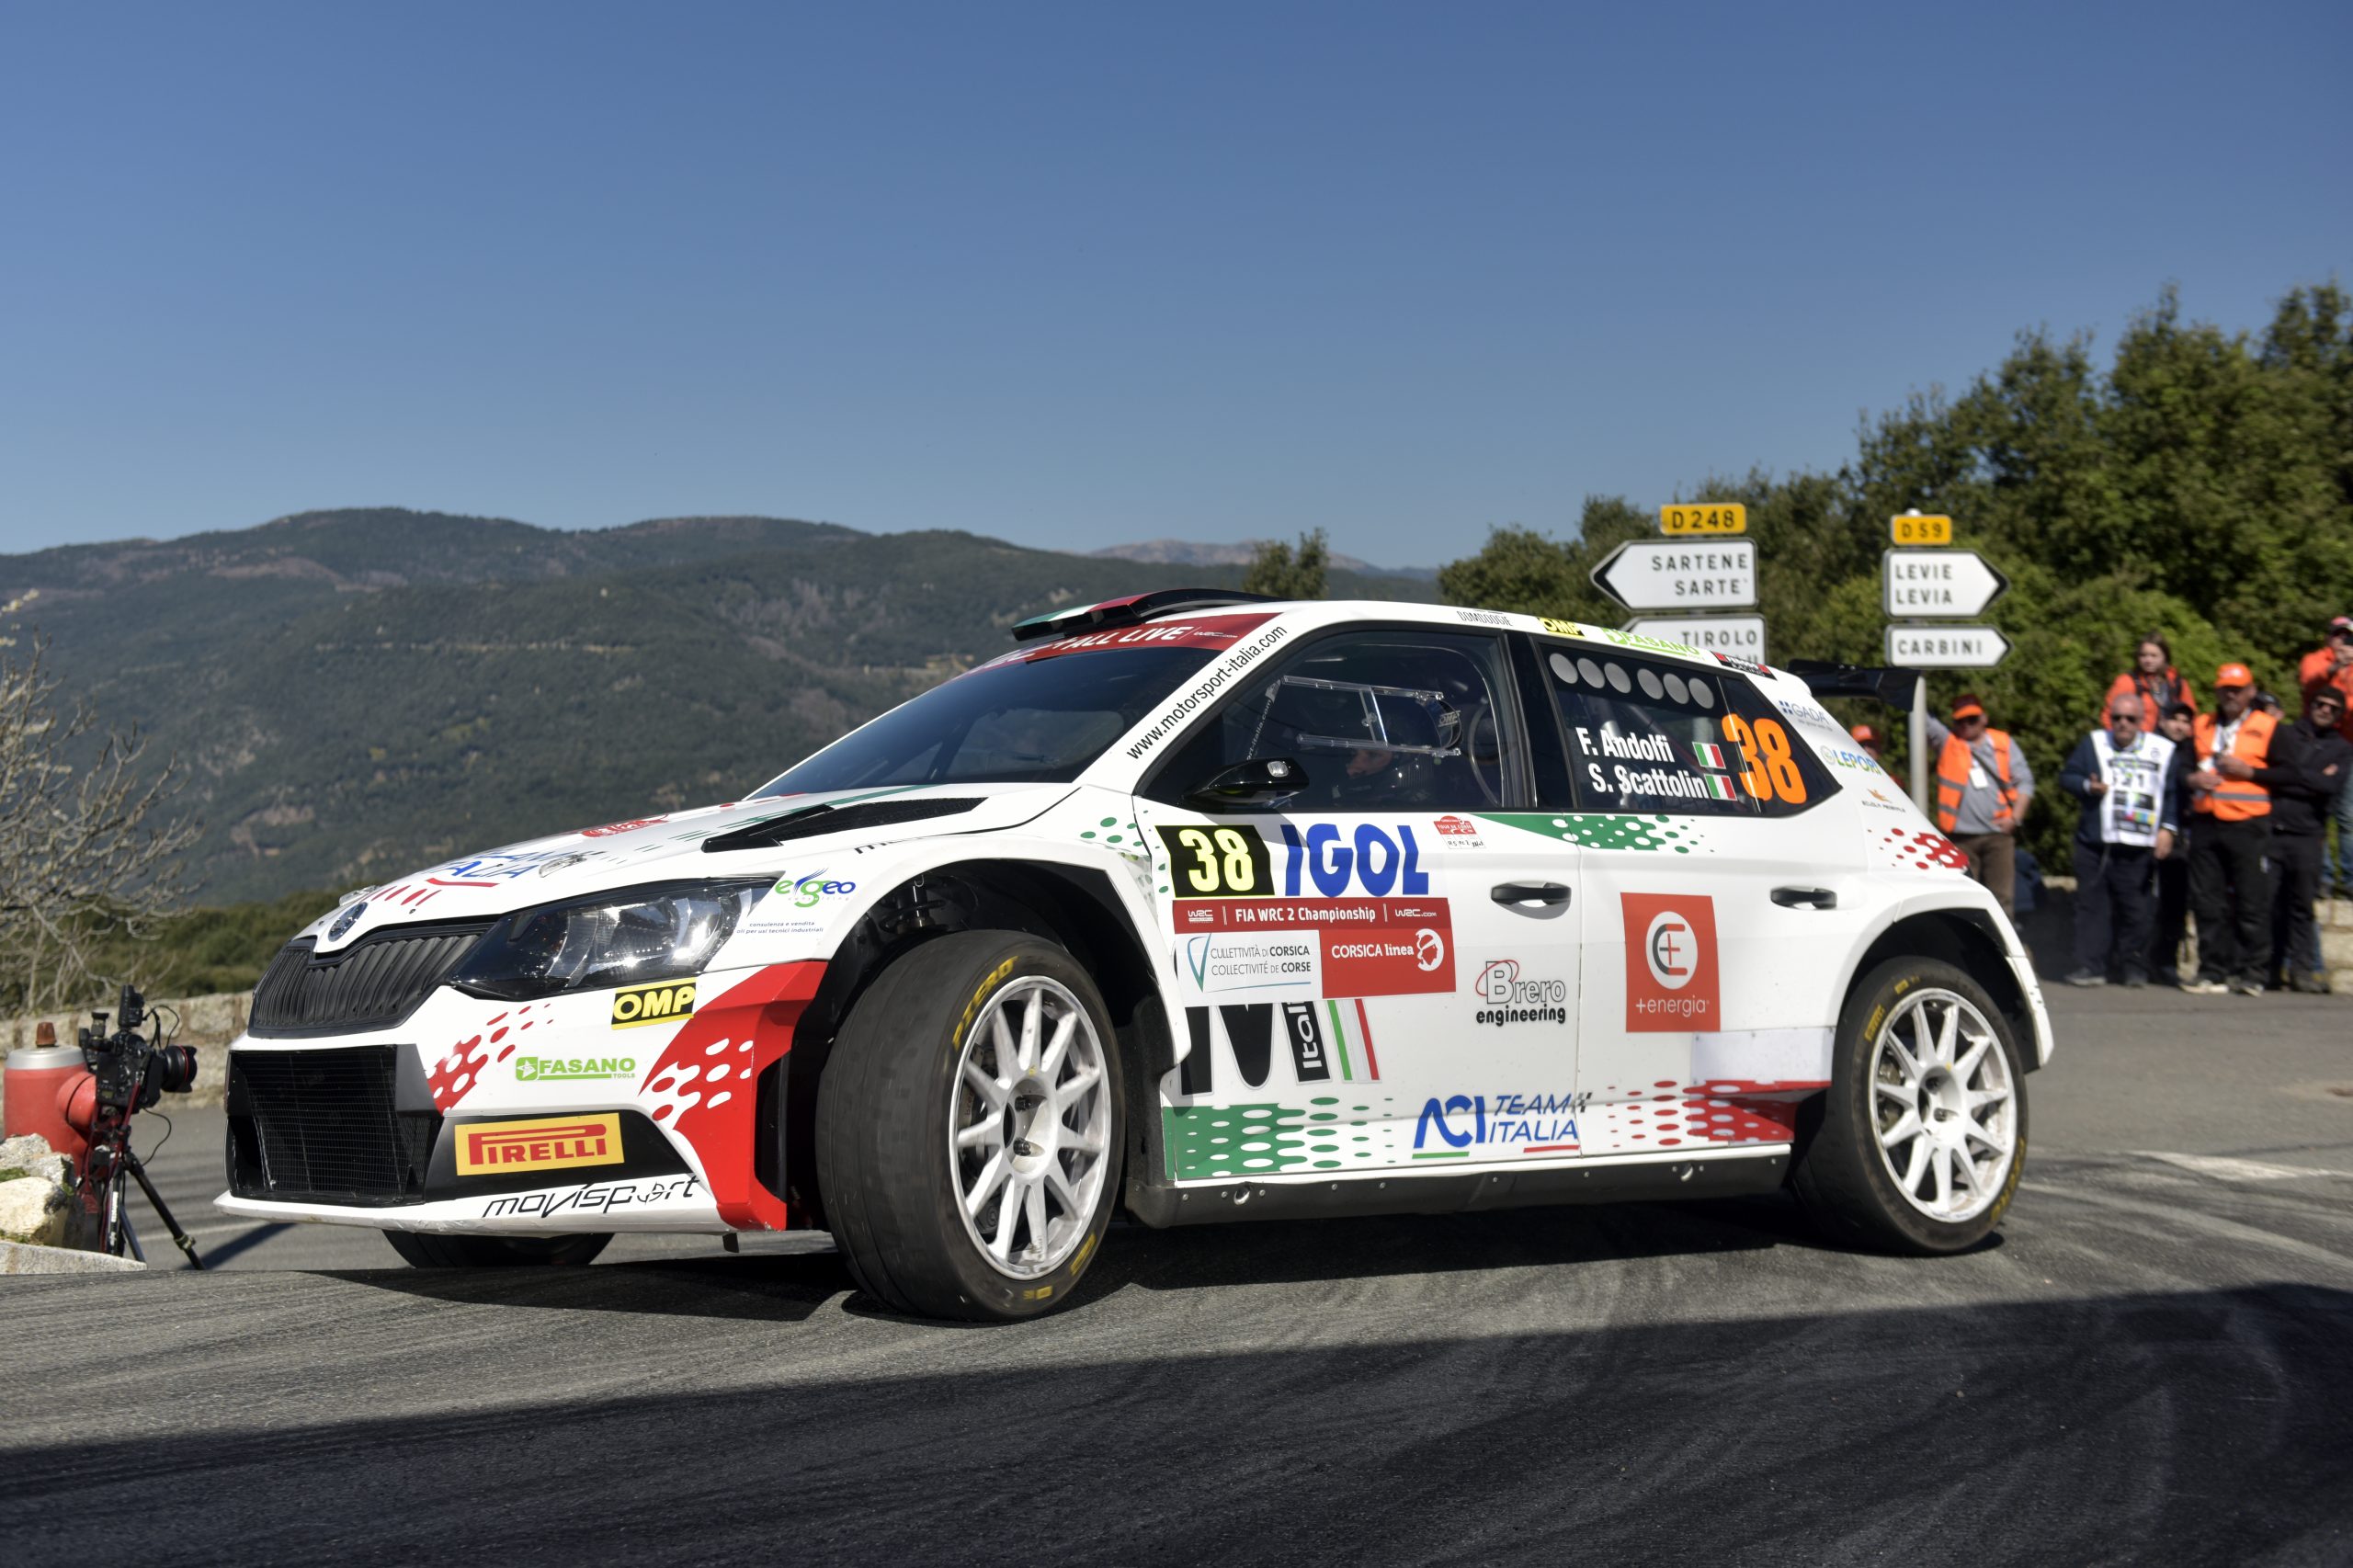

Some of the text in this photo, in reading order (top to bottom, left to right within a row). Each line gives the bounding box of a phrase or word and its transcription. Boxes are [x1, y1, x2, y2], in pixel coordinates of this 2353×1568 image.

[1672, 510, 1734, 529] D 248
[1902, 522, 1943, 539] D 59
[1652, 553, 1748, 572] SARTENE
[1895, 563, 1953, 580] LEVIE
[1895, 589, 1953, 605] LEVIA
[1118, 626, 1194, 642] LIVE
[1681, 631, 1757, 647] TIROLO
[1897, 639, 1983, 656] CARBINI
[1127, 625, 1289, 759] www.motorsport-italia.com
[1575, 727, 1675, 763] F. Andolfi
[1722, 713, 1807, 804] 38
[1833, 749, 1881, 776] LEPORI
[1588, 763, 1710, 800] S. Scattolin
[1178, 824, 1429, 897] 38 IGOL
[1188, 909, 1213, 917] WRC
[1235, 905, 1376, 923] FIA WRC 2 Championship
[1211, 944, 1261, 960] CULLETTIVITÀ
[1269, 945, 1311, 958] CORSICA
[1331, 942, 1415, 959] CORSICA linea
[1211, 960, 1268, 976] COLLECTIVITÉ
[1281, 961, 1312, 973] CORSE
[1485, 960, 1566, 1005] Brero
[613, 985, 696, 1020] OMP
[1476, 1004, 1566, 1027] engineering
[540, 1057, 636, 1074] FASANO
[1494, 1093, 1573, 1116] TEAM
[1489, 1119, 1579, 1143] ITALIA
[468, 1123, 608, 1165] PIRELLI
